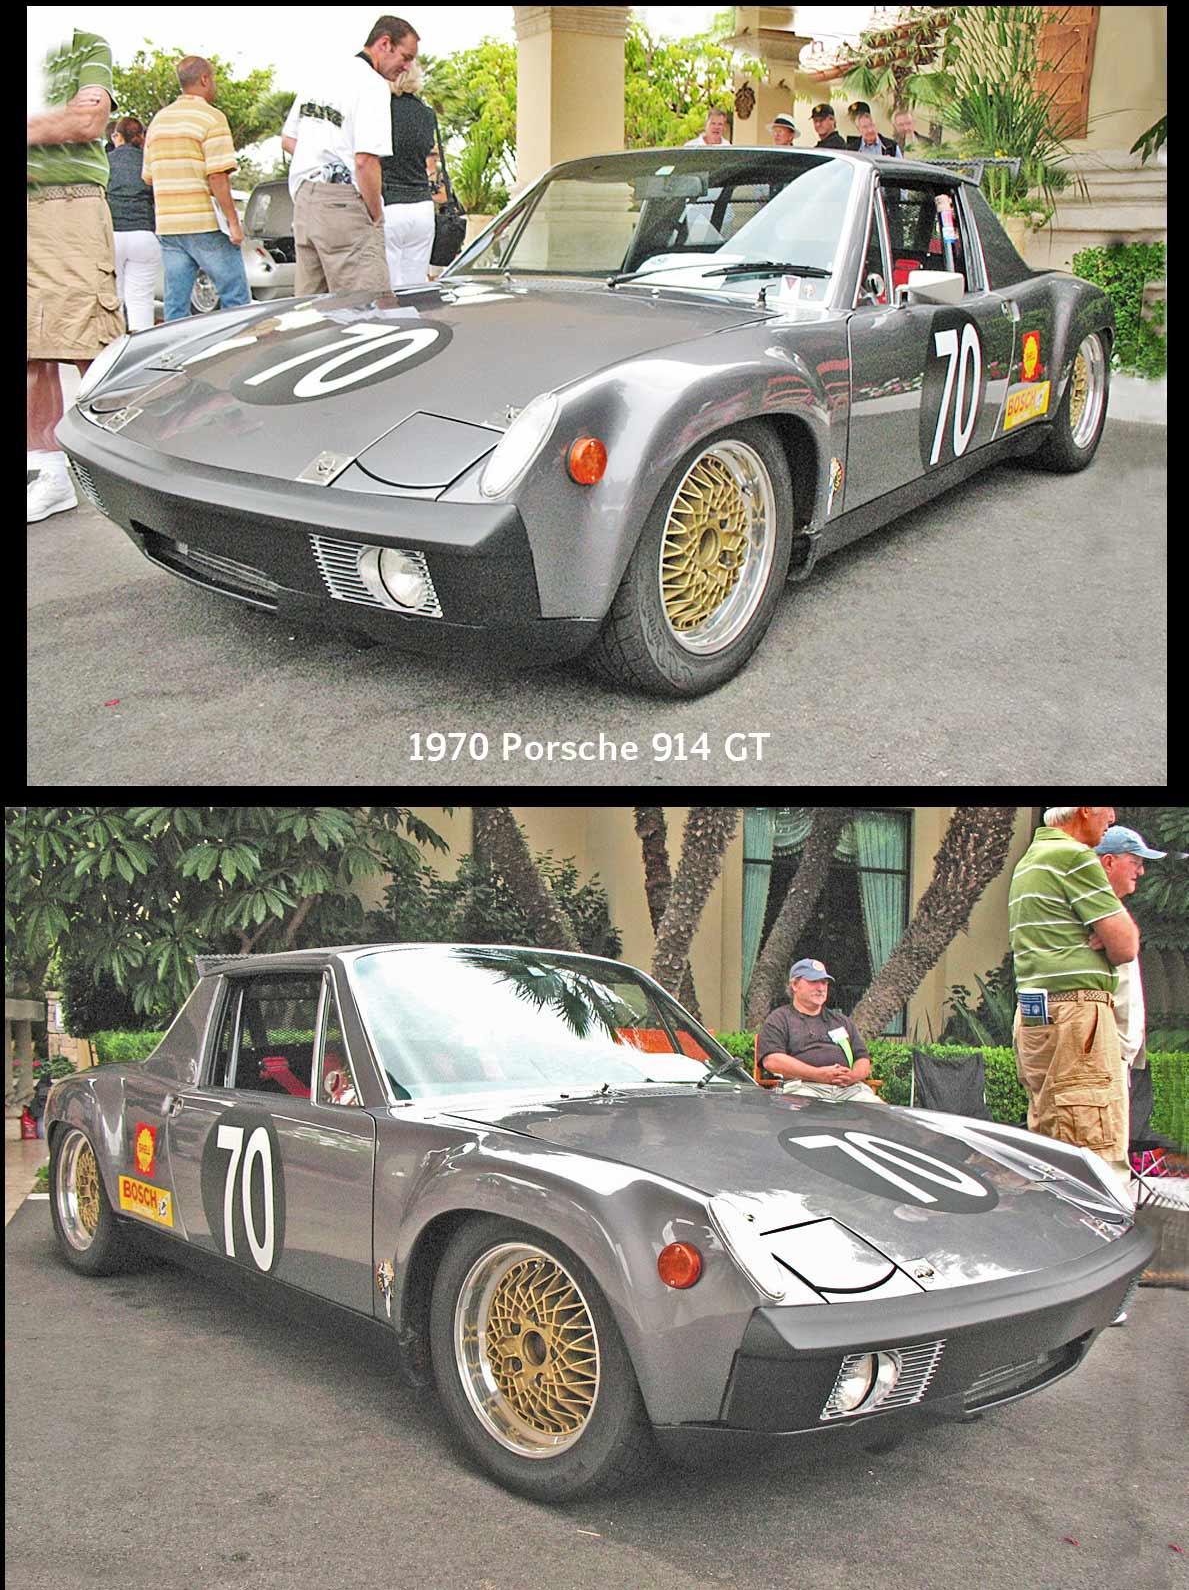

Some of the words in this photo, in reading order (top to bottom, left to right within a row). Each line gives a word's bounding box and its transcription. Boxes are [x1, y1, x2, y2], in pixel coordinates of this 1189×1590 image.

[243, 322, 440, 398] 70
[929, 322, 982, 466] 70
[1007, 389, 1037, 417] BOSCH
[122, 1179, 158, 1209] BOSCH
[216, 1125, 275, 1272] 70
[788, 1131, 988, 1204] 70
